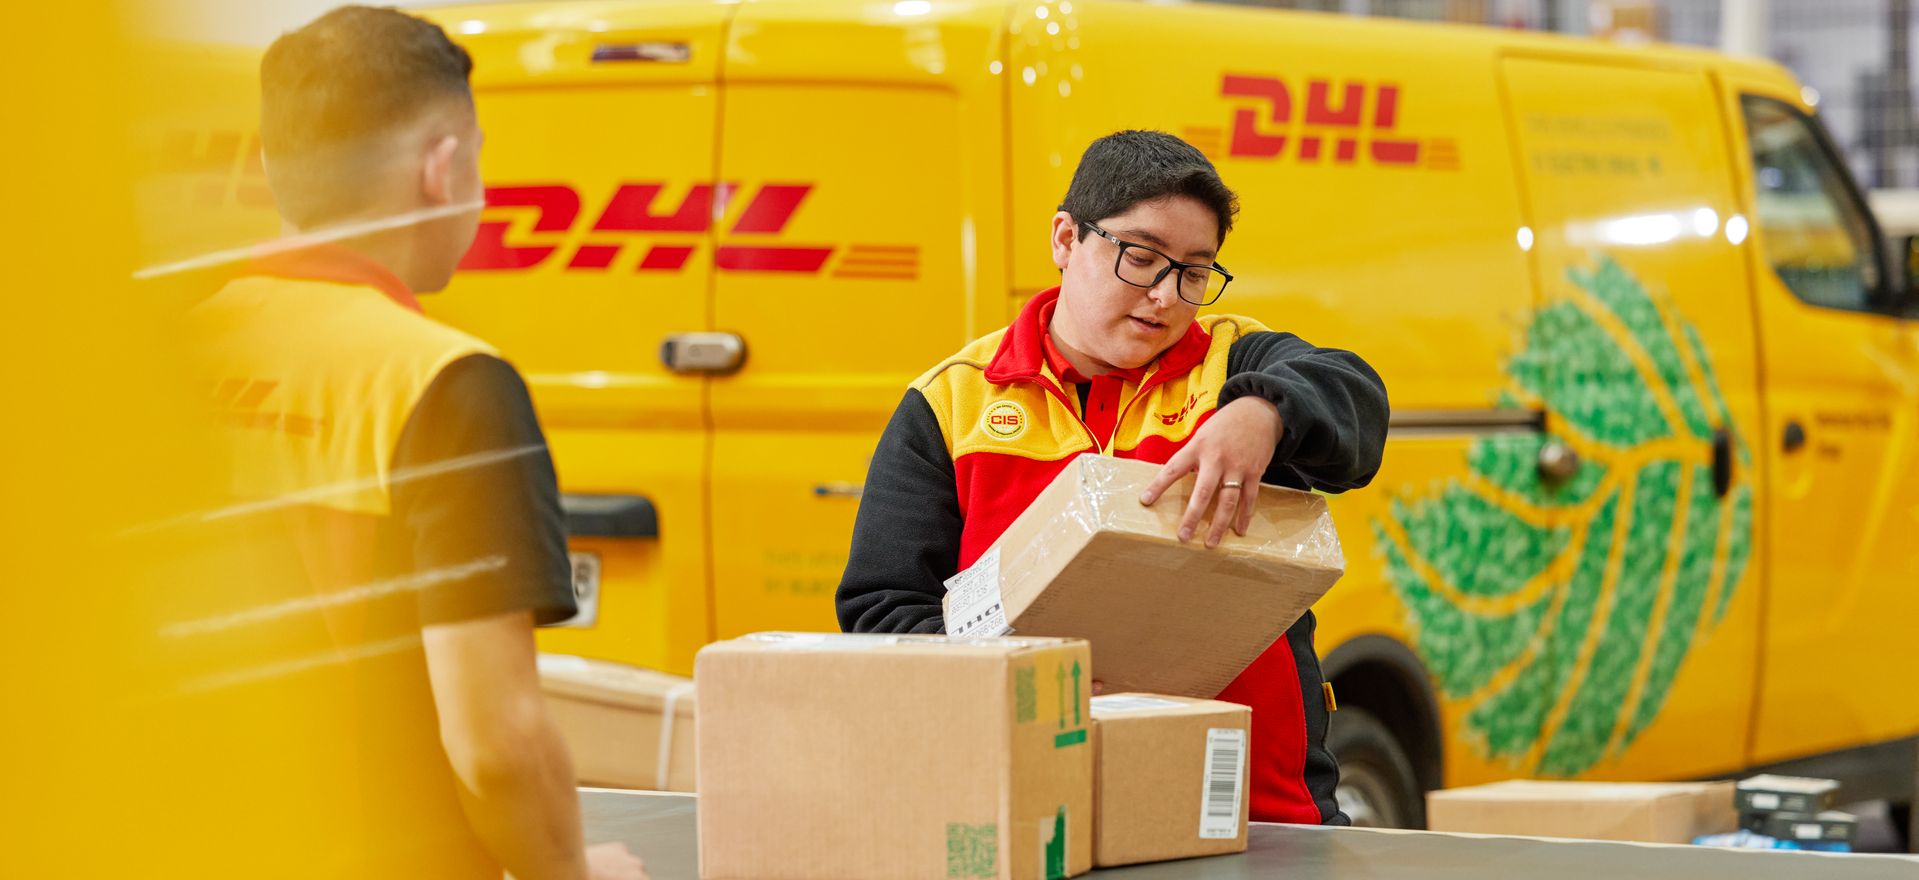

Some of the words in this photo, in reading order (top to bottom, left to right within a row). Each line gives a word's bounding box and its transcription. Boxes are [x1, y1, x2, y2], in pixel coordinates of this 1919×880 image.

[1221, 74, 1420, 164] DHL
[456, 183, 833, 272] DHL
[990, 415, 1019, 426] CIS
[950, 603, 1000, 635] DHL
